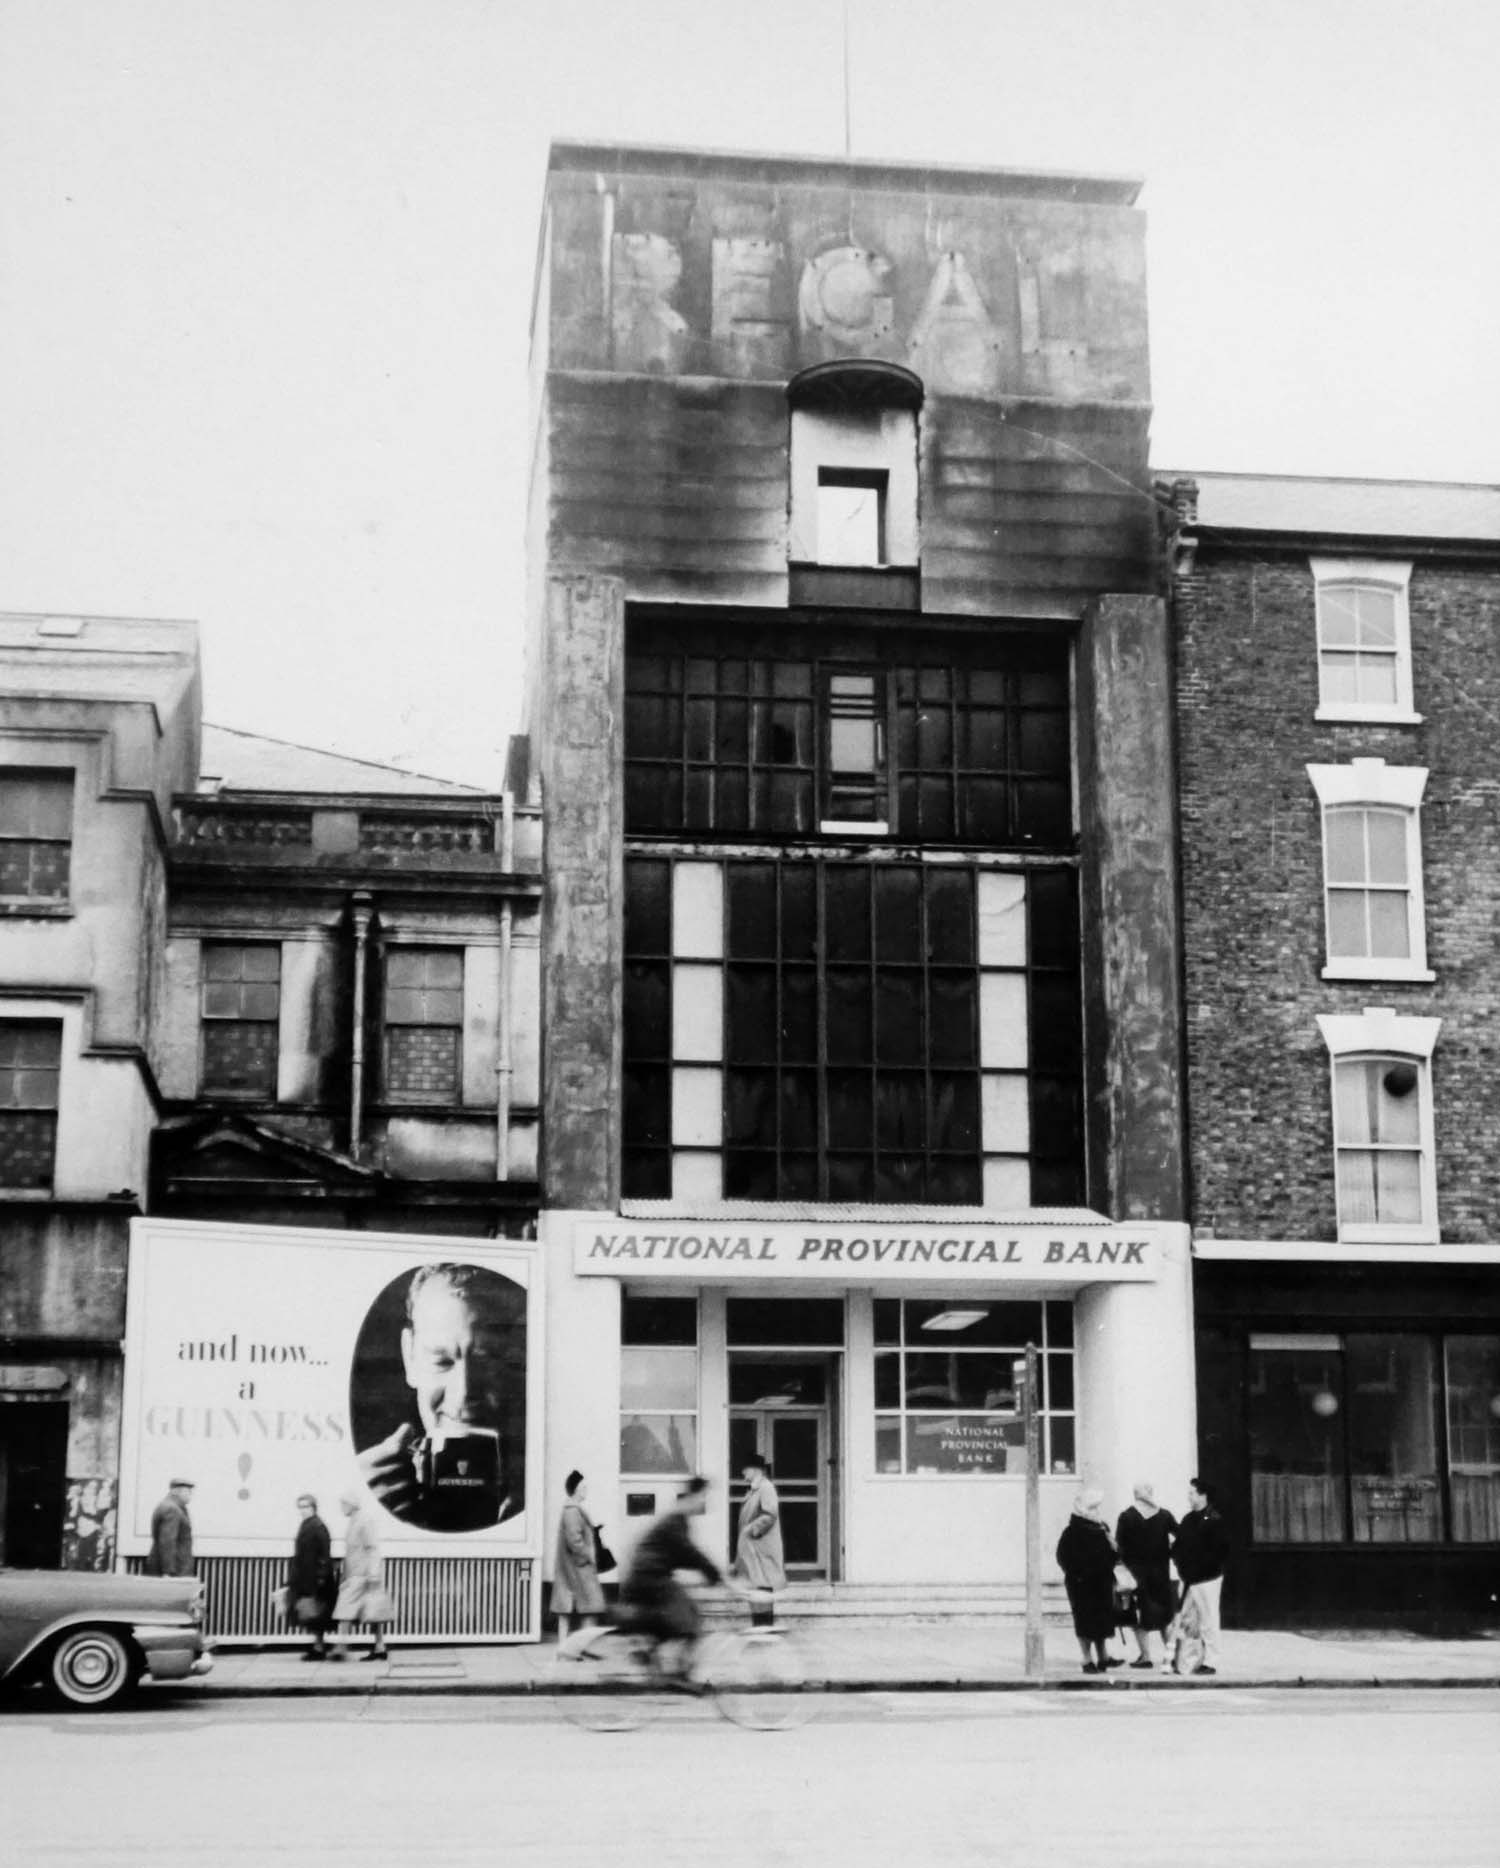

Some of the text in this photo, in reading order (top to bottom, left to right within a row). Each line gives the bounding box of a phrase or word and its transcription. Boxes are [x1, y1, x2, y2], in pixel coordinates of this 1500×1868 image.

[588, 1235, 1150, 1264] NATIONAL PROVINCIAL BANK
[178, 1334, 237, 1362] and
[239, 1381, 255, 1400] a
[145, 1407, 346, 1440] GUINNESS
[945, 1427, 1005, 1437] NATIONAL
[940, 1440, 1008, 1450] PROVINCIAL
[957, 1454, 993, 1463] BANK
